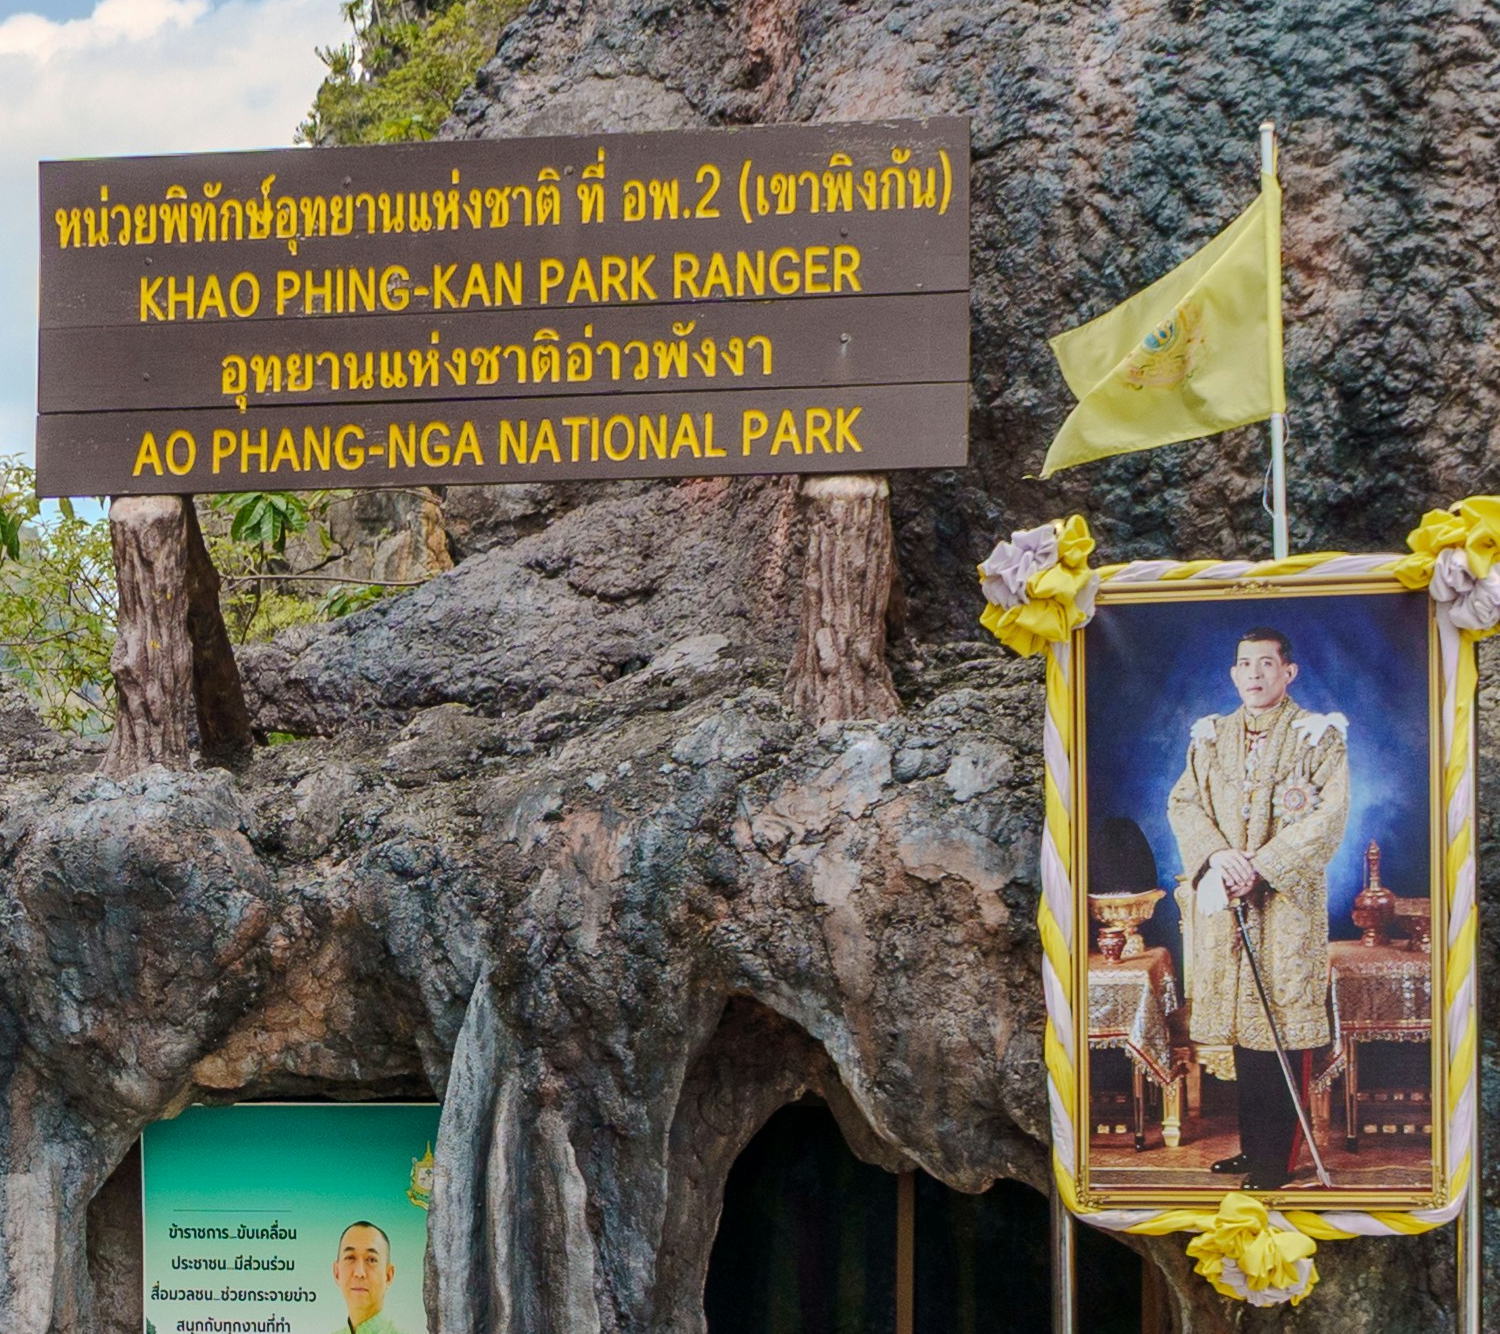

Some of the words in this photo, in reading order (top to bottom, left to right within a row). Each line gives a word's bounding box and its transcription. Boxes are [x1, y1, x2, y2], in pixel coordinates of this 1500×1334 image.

[56, 168, 562, 256] หน่วยพิทักษ์อุทยานแห่งชาติ
[580, 150, 606, 225] ที่
[623, 164, 720, 226] อพ.2
[740, 147, 952, 225] (เขาพิงกัน)
[138, 271, 259, 323] KHAO
[275, 261, 523, 317] PHING-KAN
[539, 254, 656, 305] PARK
[673, 245, 862, 299] RANGER
[220, 322, 774, 413] อุทยานแห่งชาติอ่าวพังงา
[132, 432, 195, 477] AO
[211, 420, 480, 475] PHANG-NGA
[498, 412, 727, 466] NATIONAL
[741, 407, 863, 456] PARK
